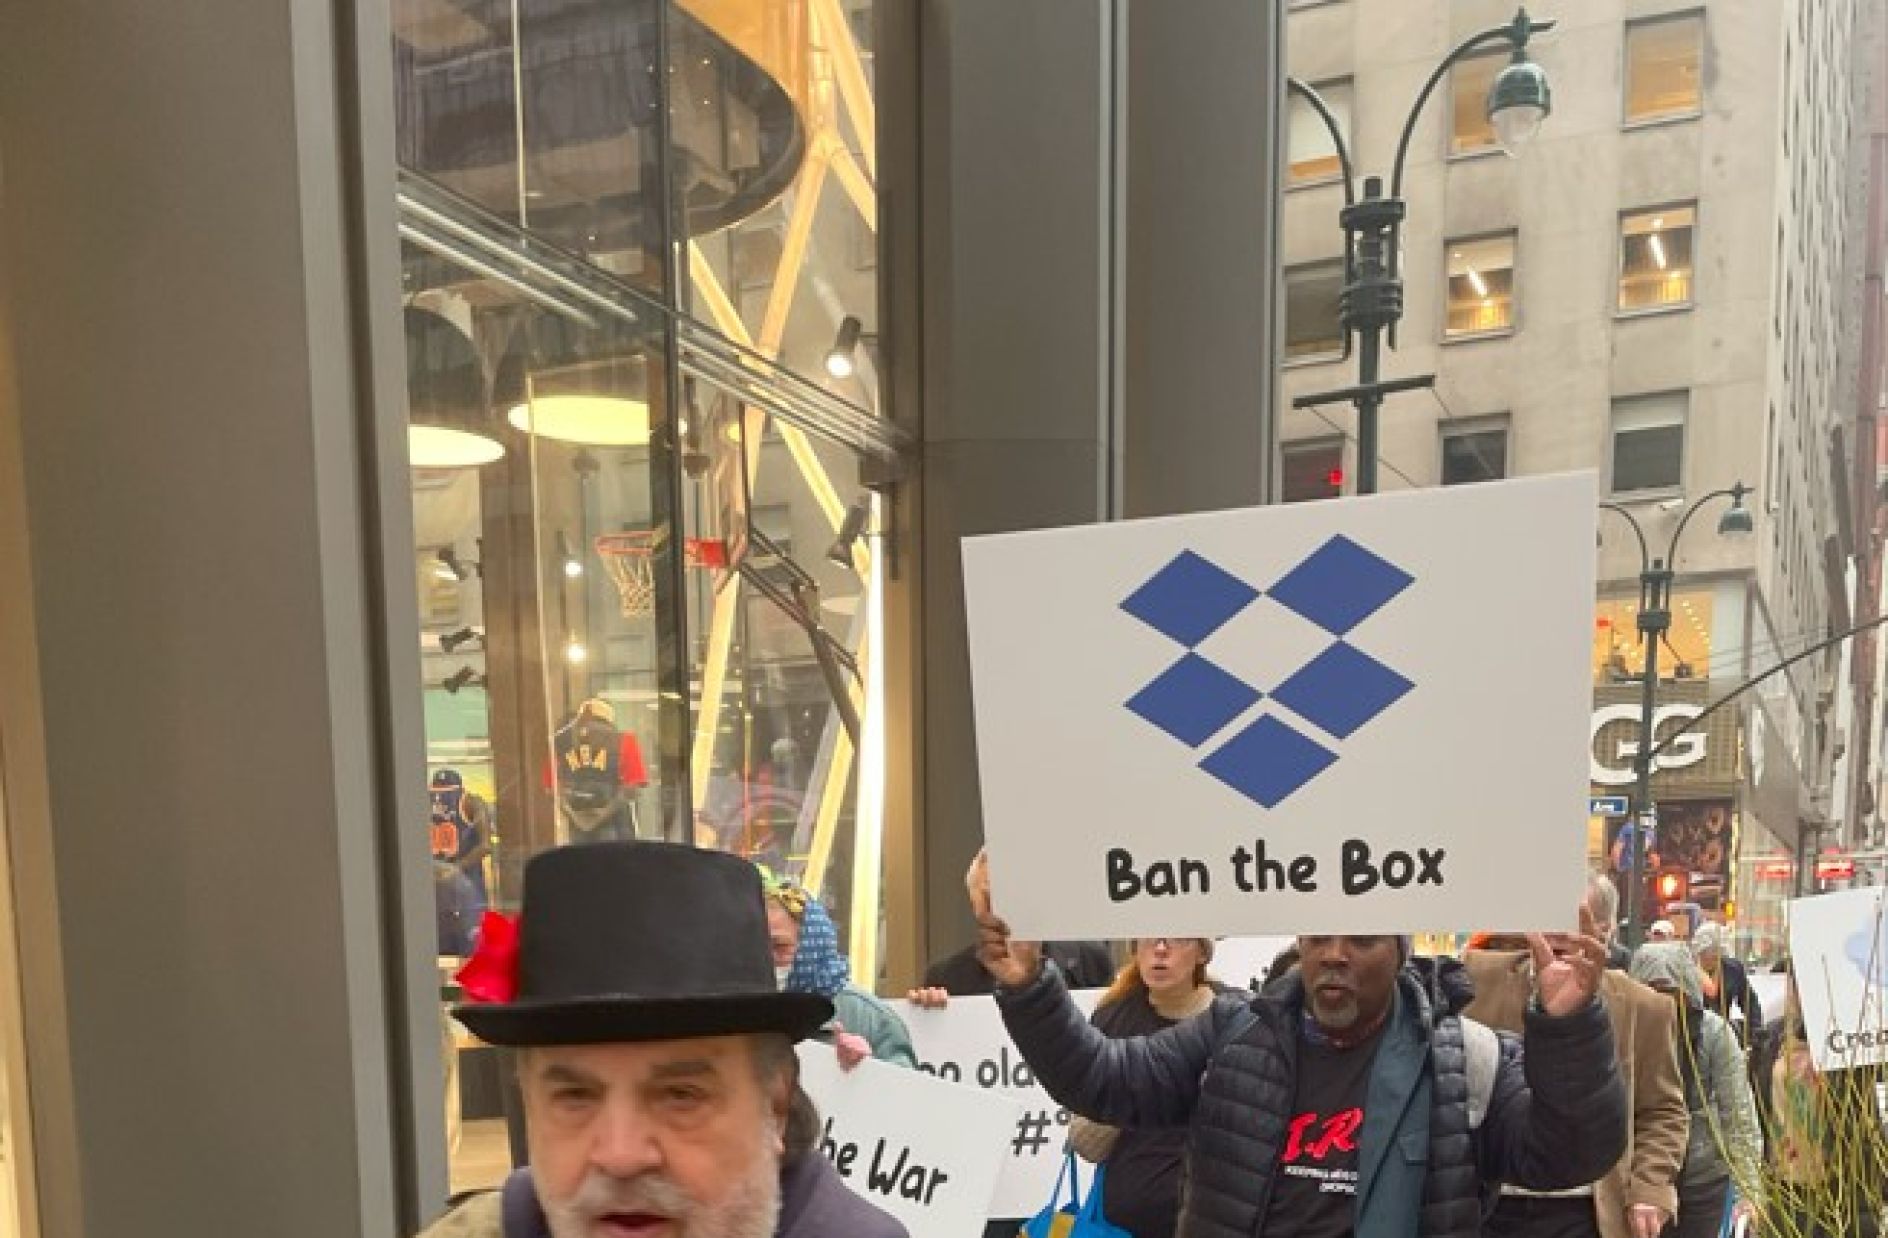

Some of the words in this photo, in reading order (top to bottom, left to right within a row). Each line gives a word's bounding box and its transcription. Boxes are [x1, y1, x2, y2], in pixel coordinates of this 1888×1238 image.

[1105, 847, 1210, 903] Ban
[1229, 839, 1318, 893] the
[1341, 839, 1446, 896] Box
[820, 1116, 858, 1178] he
[867, 1136, 948, 1205] War
